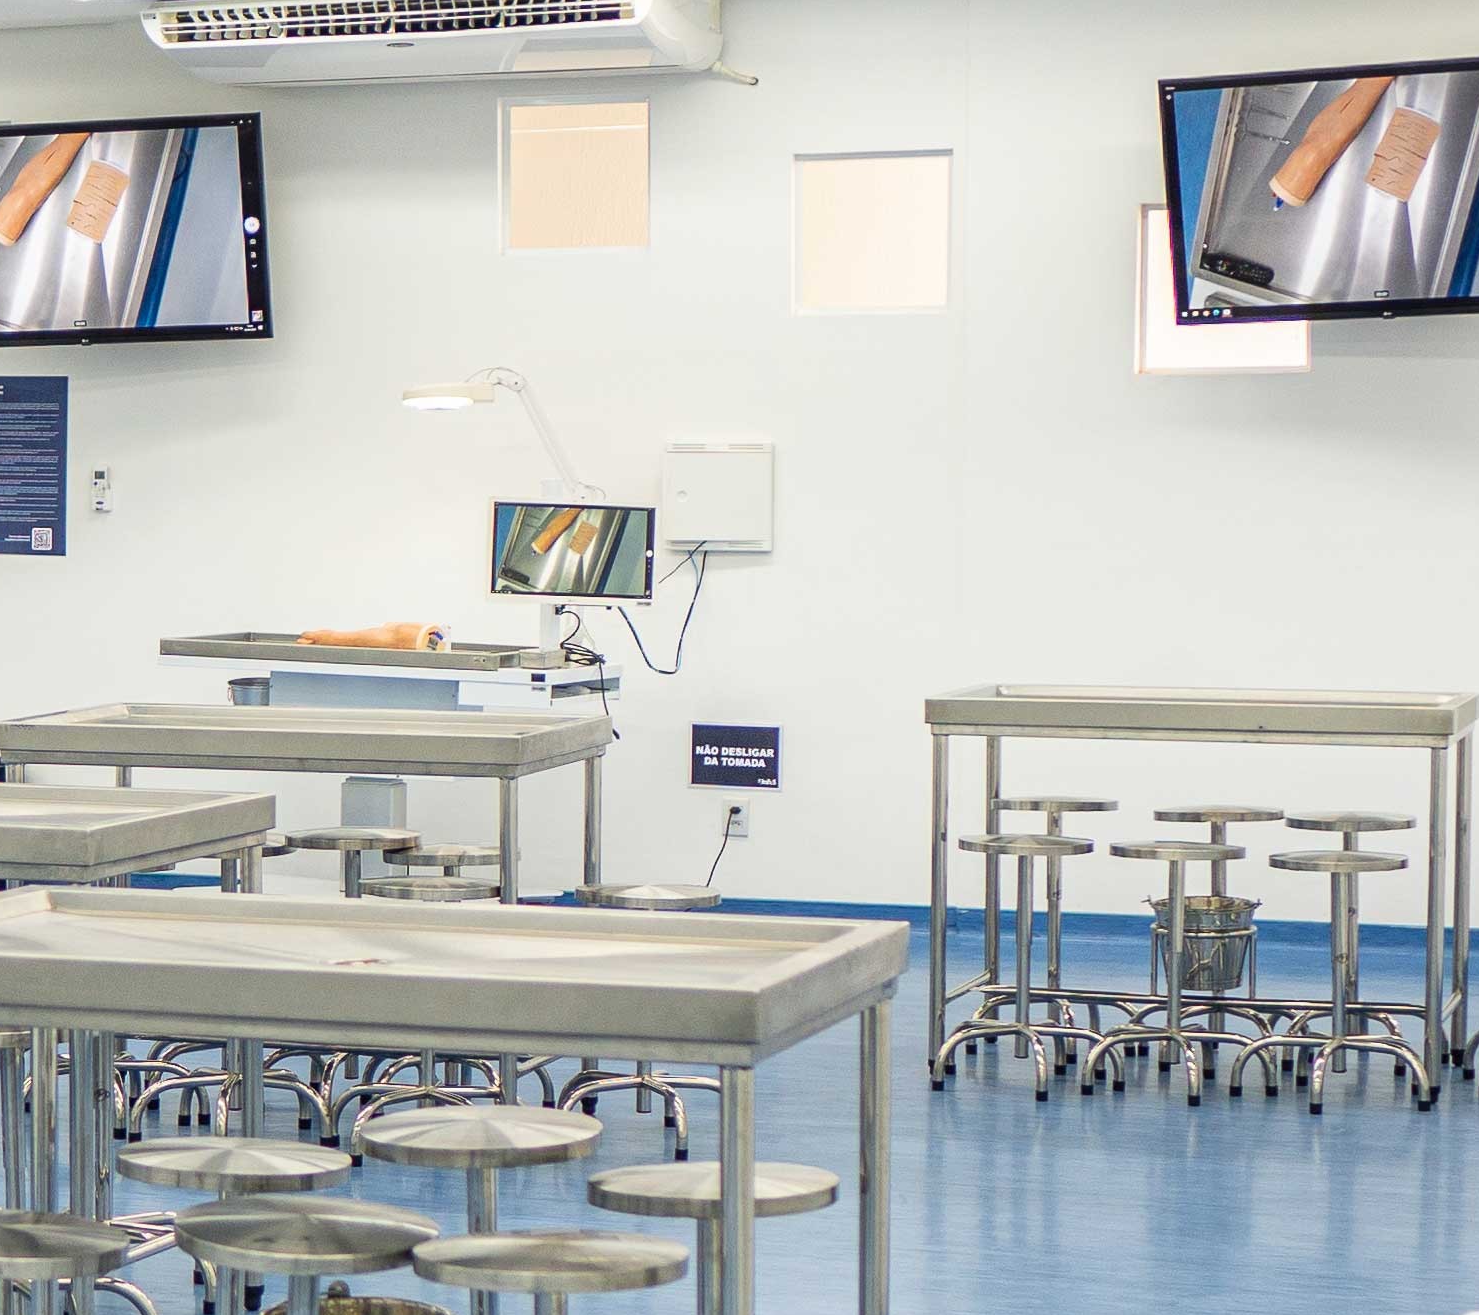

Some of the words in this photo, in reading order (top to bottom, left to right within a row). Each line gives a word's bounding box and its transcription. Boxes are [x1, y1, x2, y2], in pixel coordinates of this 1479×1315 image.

[695, 744, 719, 755] NÃO
[721, 747, 775, 758] DESLIGAR
[704, 757, 719, 766] DA
[721, 757, 767, 768] TOMADA
